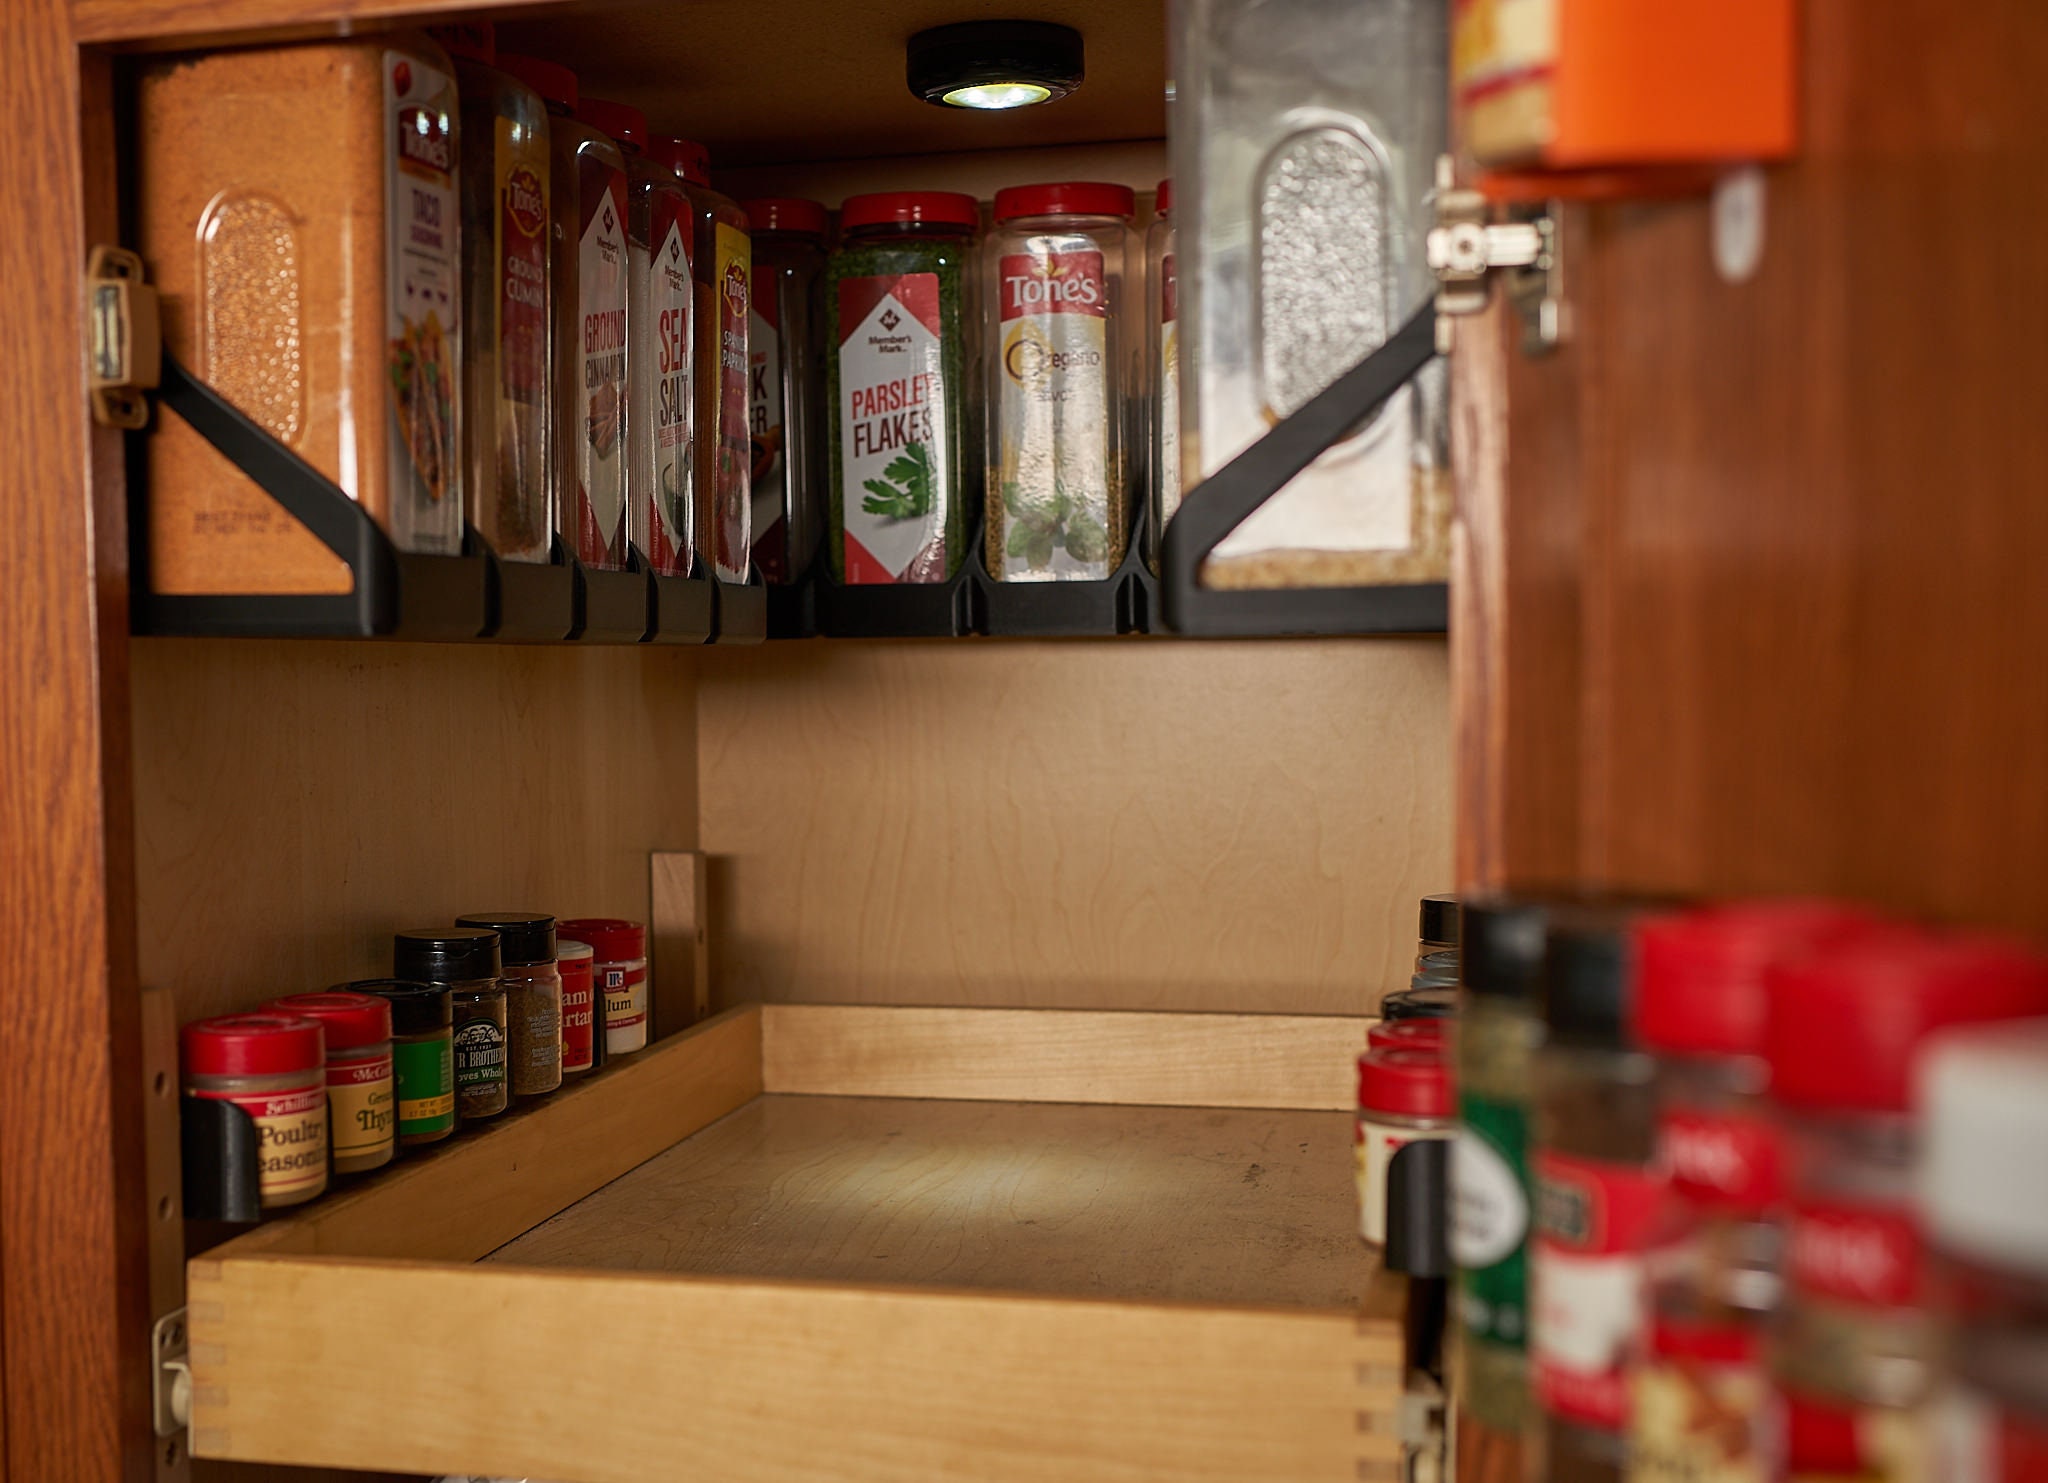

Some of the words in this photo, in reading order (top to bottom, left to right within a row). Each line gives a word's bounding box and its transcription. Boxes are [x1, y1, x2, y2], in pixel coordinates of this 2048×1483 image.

[511, 181, 543, 221] Tone's
[506, 277, 544, 310] CUMIN
[726, 274, 747, 301] Tone's
[1005, 272, 1098, 308] Tone's
[584, 309, 626, 354] GROUND
[659, 307, 687, 374] SEA
[868, 335, 912, 345] Member's
[585, 352, 626, 389] CINNAMON
[660, 374, 688, 427] SALT
[854, 407, 932, 458] FLAKES
[562, 1010, 593, 1028] rtar
